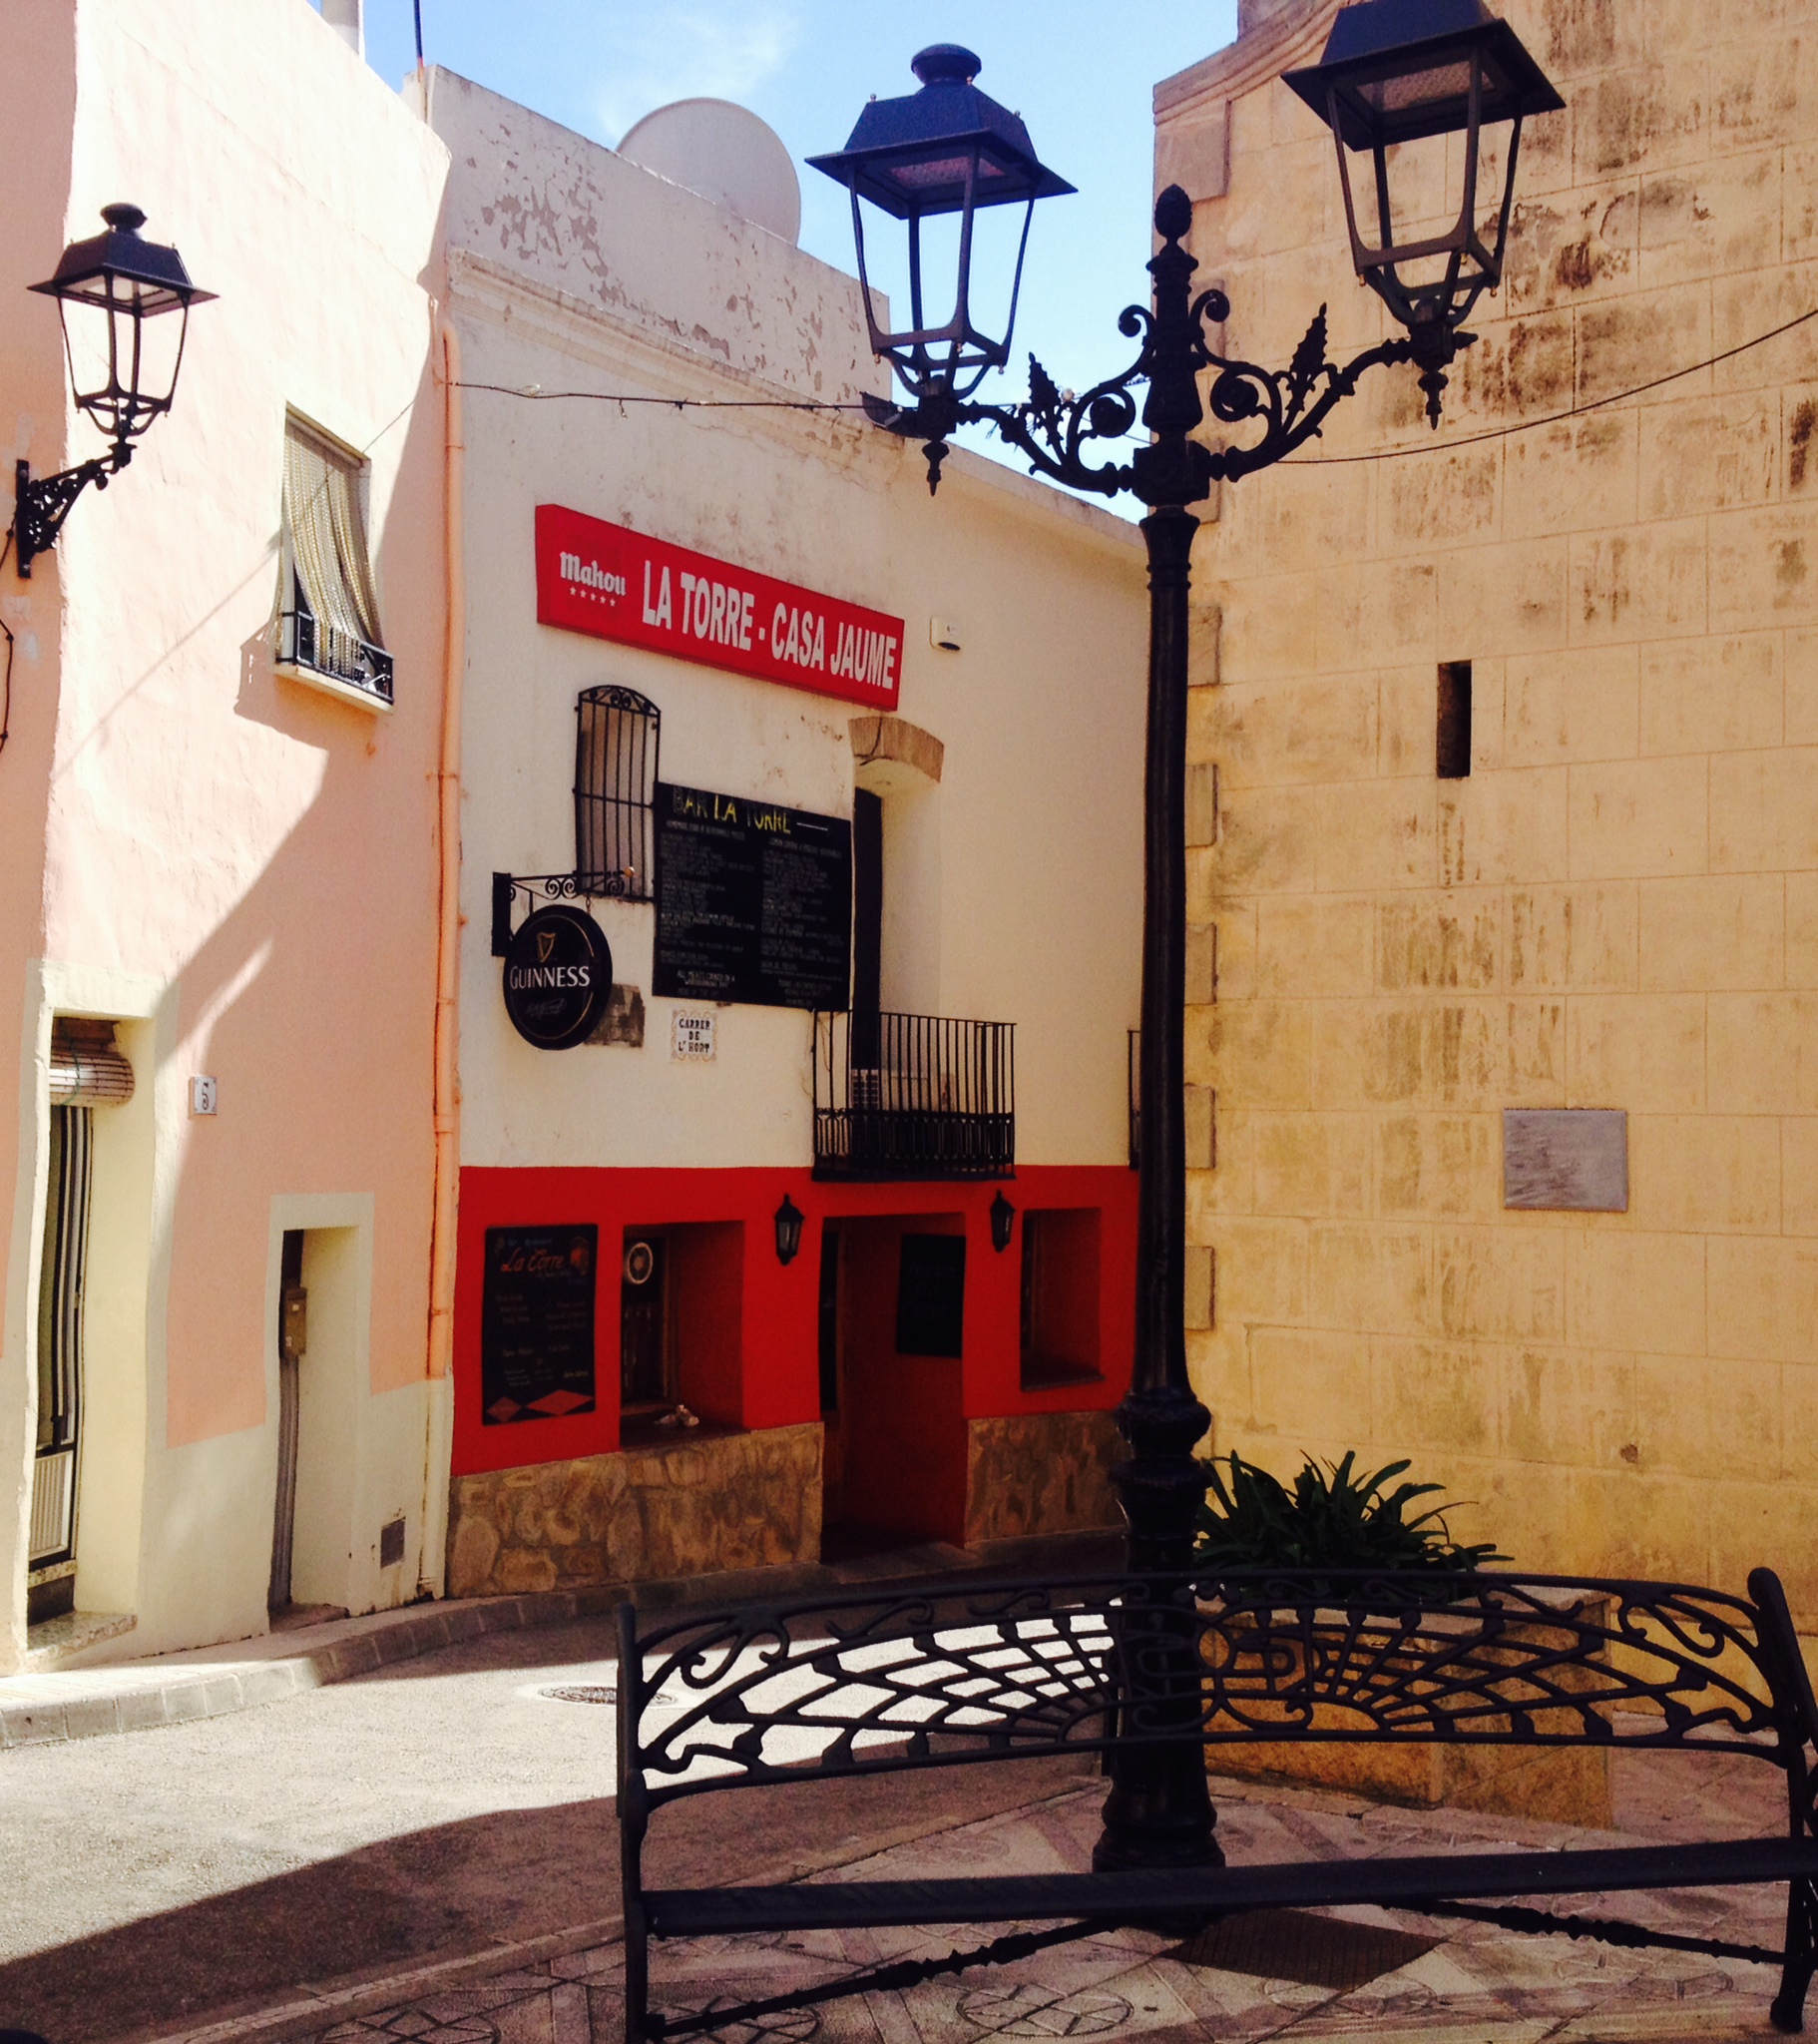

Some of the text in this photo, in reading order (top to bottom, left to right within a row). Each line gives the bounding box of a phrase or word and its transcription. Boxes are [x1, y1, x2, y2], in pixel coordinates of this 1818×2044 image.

[559, 551, 627, 597] Mahou
[642, 560, 673, 630] LA
[681, 572, 755, 651] TORRE
[771, 602, 825, 671] CASA
[830, 622, 898, 690] JAUME
[673, 786, 708, 818] BAR
[713, 793, 737, 823] LA
[509, 965, 591, 989] GUINNESS
[679, 1018, 710, 1030] CARRER
[688, 1030, 700, 1041] DE
[202, 1082, 210, 1111] 5
